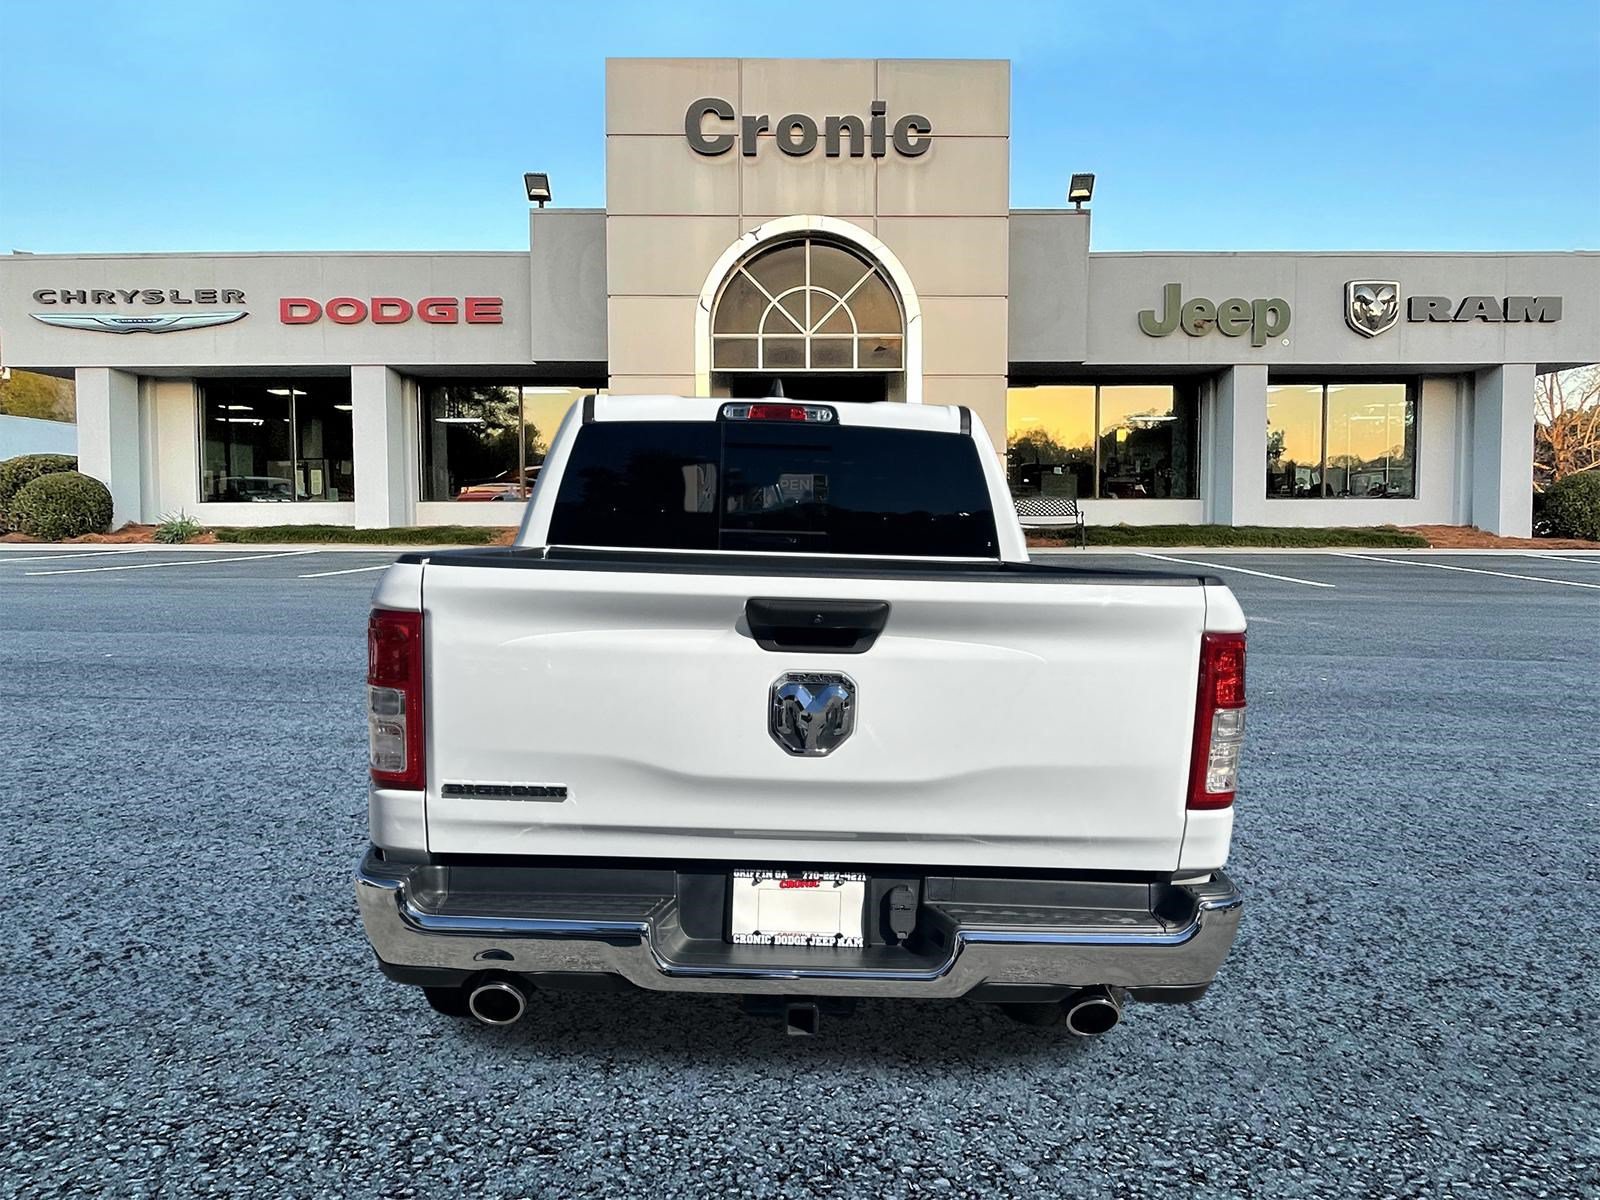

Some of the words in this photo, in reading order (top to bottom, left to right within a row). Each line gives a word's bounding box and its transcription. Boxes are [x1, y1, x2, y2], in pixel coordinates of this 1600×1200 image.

[685, 98, 932, 157] Cronic
[33, 288, 246, 305] CHRYSLER
[1407, 296, 1563, 322] RAM
[280, 296, 503, 325] DODGE
[1138, 283, 1291, 347] Jeep
[779, 880, 821, 888] CRONIC
[733, 934, 772, 944] CRONIC
[774, 935, 807, 946] DODGE
[809, 936, 836, 947] JEEP
[837, 936, 864, 948] RAM
